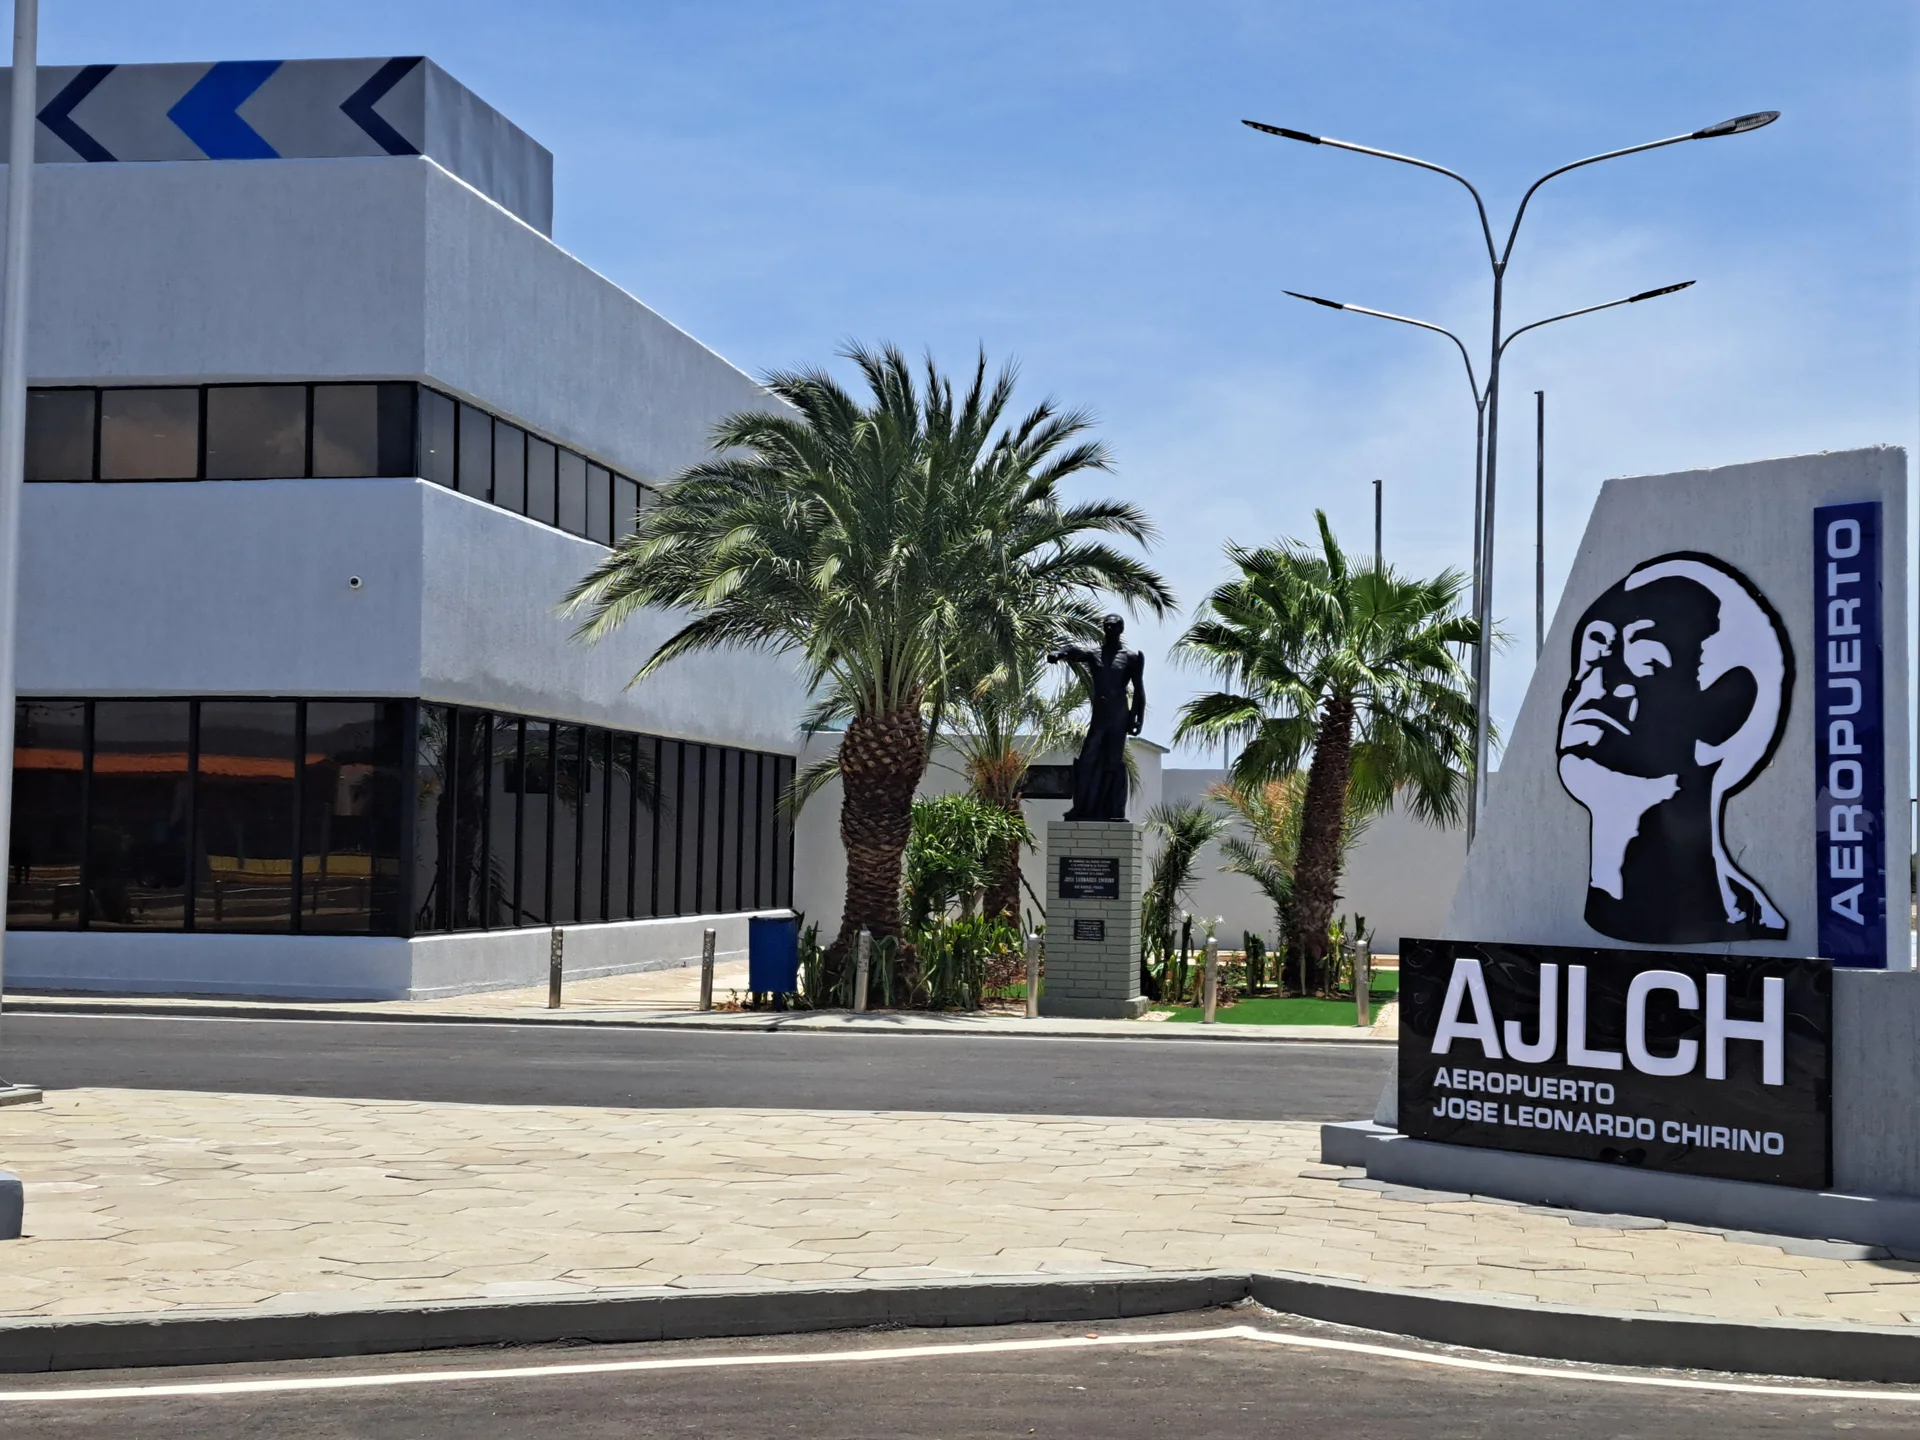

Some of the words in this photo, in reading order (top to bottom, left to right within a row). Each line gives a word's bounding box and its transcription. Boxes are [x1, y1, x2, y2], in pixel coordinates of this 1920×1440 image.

[1827, 518, 1864, 925] AEROPUERTO
[1431, 958, 1785, 1086] AJLCH
[1433, 1066, 1615, 1105] AEROPUERTO
[1433, 1096, 1498, 1123] JOSE
[1504, 1105, 1655, 1141] LEONARDO
[1662, 1121, 1785, 1156] CHIRINO
